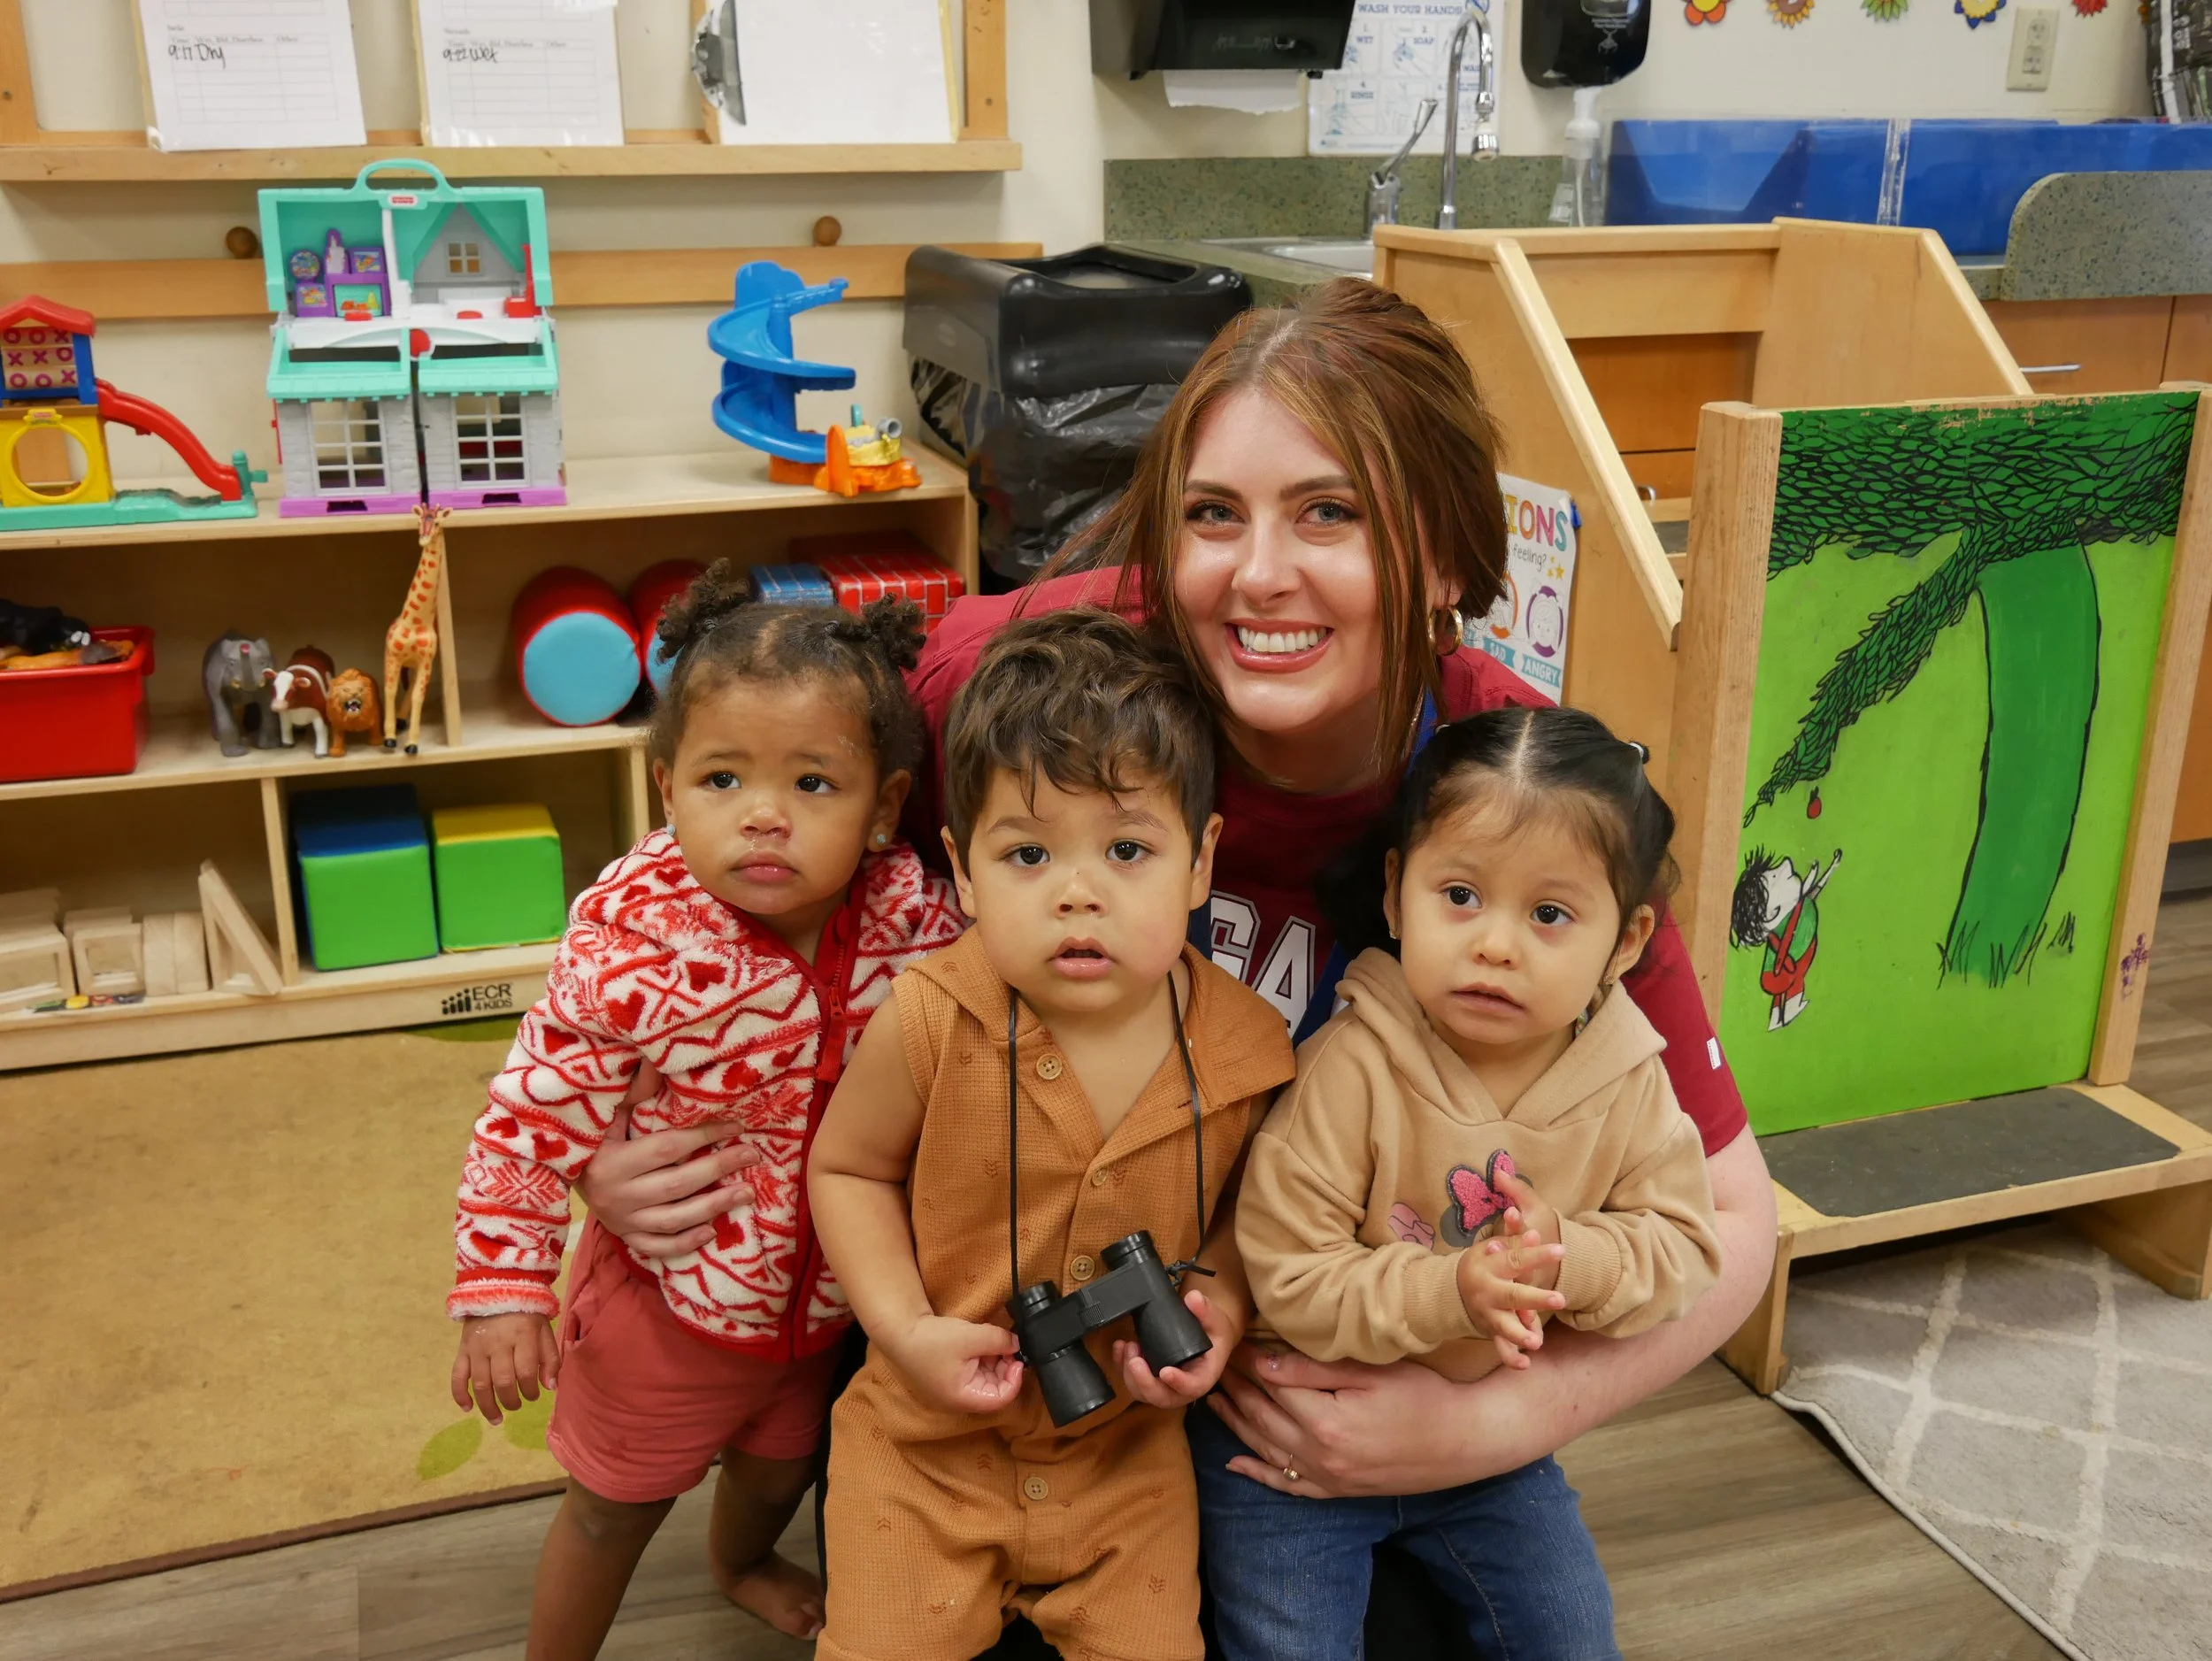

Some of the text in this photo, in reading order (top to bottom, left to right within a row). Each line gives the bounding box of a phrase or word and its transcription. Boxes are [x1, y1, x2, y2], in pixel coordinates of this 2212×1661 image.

[1357, 4, 1388, 13] WASH
[1394, 4, 1421, 14] YOUR
[195, 42, 227, 69] Dry
[469, 47, 498, 63] Wet
[1513, 543, 1547, 573] feeling?
[1524, 657, 1556, 684] ANGRY
[472, 983, 512, 1001] ECR
